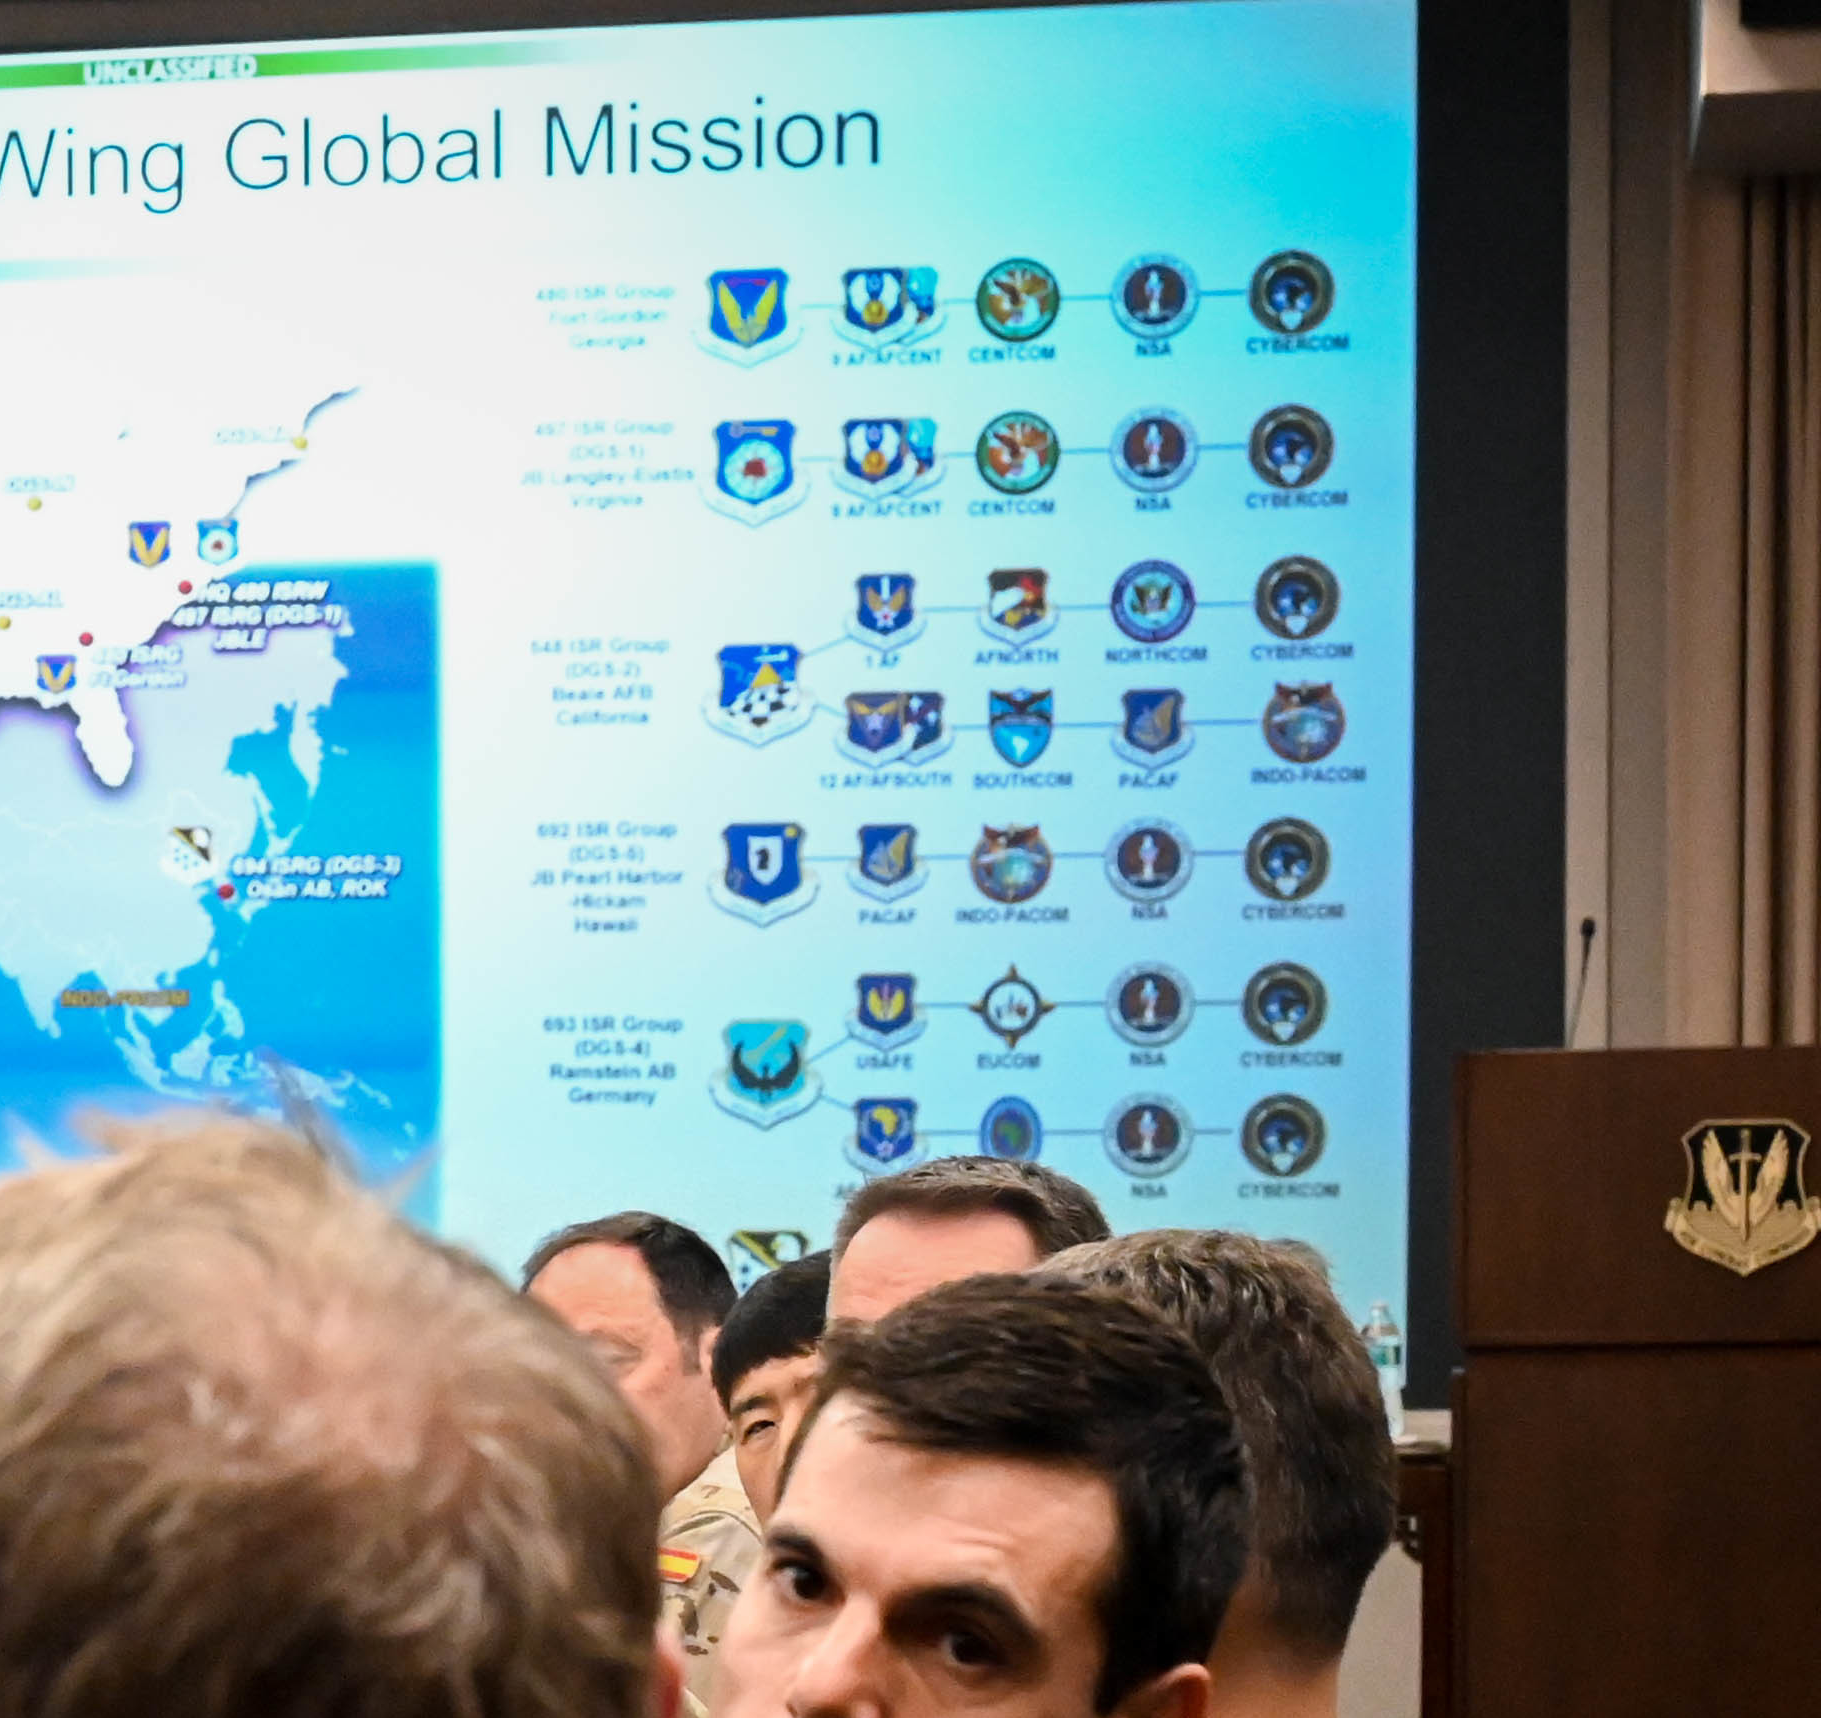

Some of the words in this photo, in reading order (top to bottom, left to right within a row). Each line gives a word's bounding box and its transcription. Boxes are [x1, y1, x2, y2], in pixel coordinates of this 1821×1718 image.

[82, 54, 257, 85] UNCLASSIFIED
[225, 108, 503, 190] Global
[544, 97, 881, 177] Mission
[614, 283, 676, 302] Group
[595, 307, 668, 324] Gordon
[570, 333, 647, 351] Georgia
[1135, 342, 1172, 358] NSA
[1246, 334, 1351, 354] CYBERCOM
[968, 346, 1056, 363] CENTCOM
[614, 419, 675, 438] Group
[570, 492, 644, 510] Virginia
[968, 500, 1055, 517] CENTCOM
[1135, 497, 1172, 513] NSA
[1245, 491, 1349, 510] CYBERCOM
[609, 636, 670, 656] Group
[1105, 645, 1208, 663] NORTHCOM
[1250, 642, 1354, 661] CYBERCOM
[974, 647, 1059, 666] AFNORTH
[552, 684, 605, 703] Beale
[613, 684, 654, 702] AFB
[556, 707, 649, 726] California
[973, 771, 1074, 790] SOUTHCOM
[1119, 771, 1180, 790] PACAF
[1250, 766, 1368, 786] INDO-PACOM
[616, 821, 677, 840] Group
[530, 869, 556, 886] JB
[562, 869, 611, 886] Pearl
[617, 868, 684, 885] Harbor
[859, 908, 917, 925] PACAF
[956, 906, 1070, 924] INDO-PACOM
[1131, 903, 1168, 921] NSA
[1242, 903, 1345, 921] CYBERCOM
[574, 917, 638, 934] Hawaii
[622, 1015, 684, 1035] Group
[856, 1053, 914, 1071] USAFE
[976, 1052, 1042, 1070] EUCOM
[1128, 1051, 1168, 1068] NSA
[1239, 1051, 1343, 1069] CYBERCOM
[550, 1063, 642, 1080] Ramstein
[647, 1063, 676, 1080] AB
[569, 1086, 657, 1106] Germany
[1130, 1183, 1168, 1200] NSA
[1237, 1181, 1341, 1200] CYBERCOM
